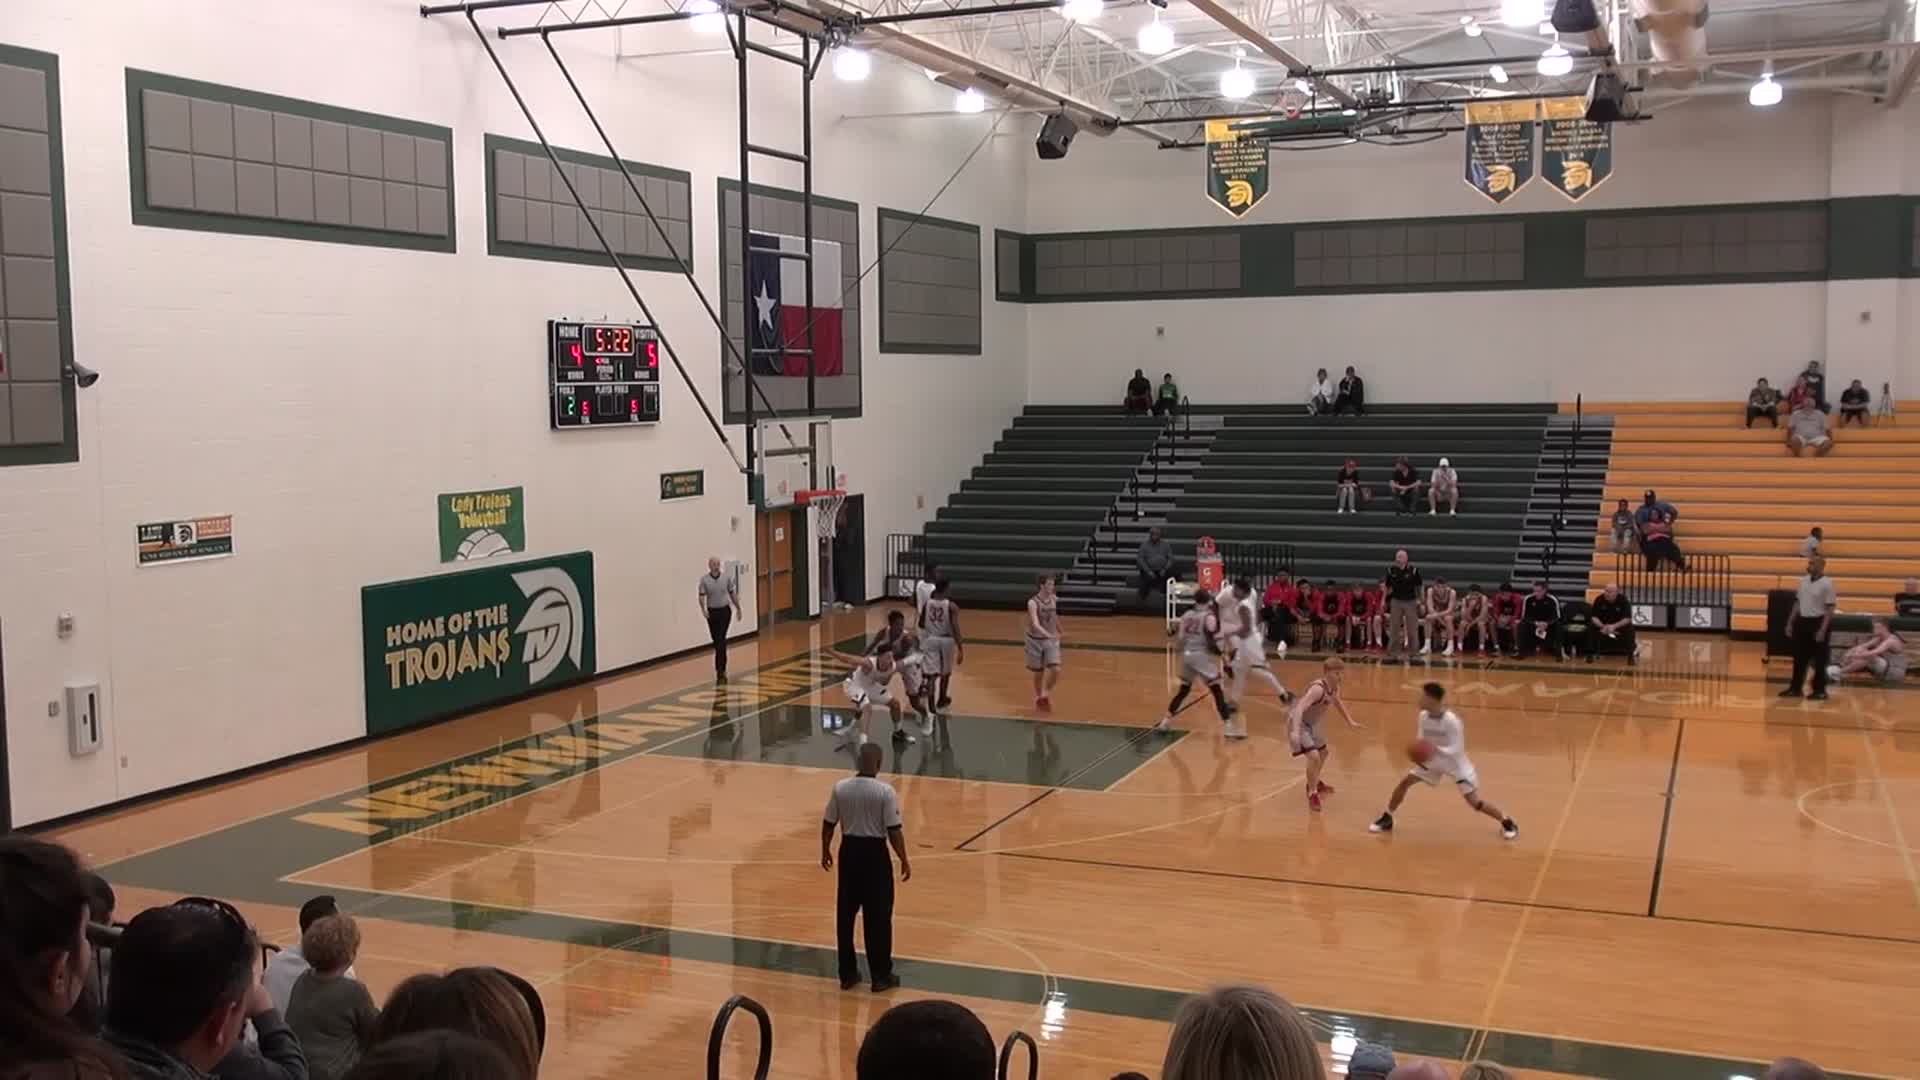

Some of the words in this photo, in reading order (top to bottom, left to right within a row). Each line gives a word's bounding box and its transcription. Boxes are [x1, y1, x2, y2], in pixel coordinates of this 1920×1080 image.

[559, 326, 580, 338] HOME
[595, 328, 630, 352] 5:22
[571, 344, 583, 367] 4
[648, 343, 657, 367] 5
[567, 396, 576, 415] 2
[451, 495, 475, 513] Lady
[476, 493, 512, 510] Trojans
[458, 508, 507, 528] Volleyball
[386, 616, 445, 647] HOME
[448, 611, 473, 634] OF
[475, 603, 508, 628] THE
[929, 607, 944, 623] 32
[385, 627, 511, 690] TROJANS
[290, 700, 728, 836] NEWMAN
